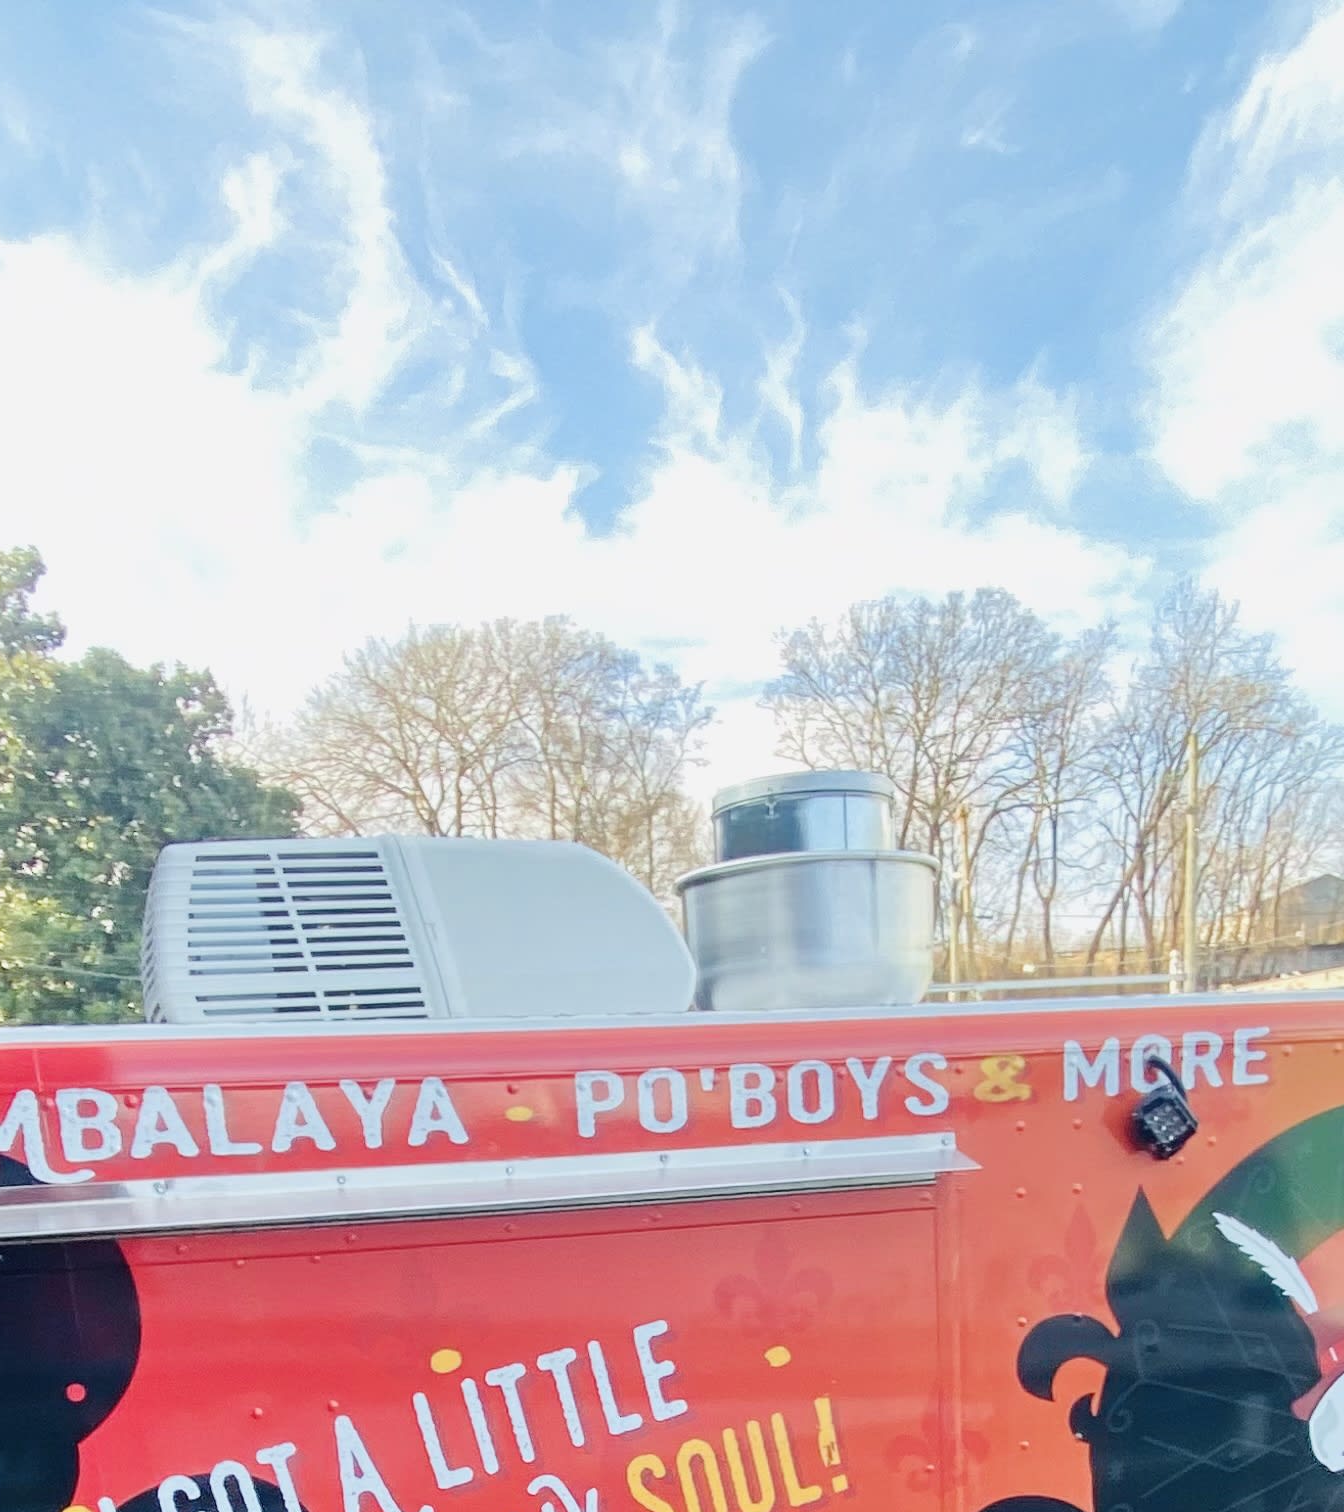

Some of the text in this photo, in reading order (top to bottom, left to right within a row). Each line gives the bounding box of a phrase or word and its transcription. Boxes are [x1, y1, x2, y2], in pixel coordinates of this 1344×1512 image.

[575, 1052, 953, 1138] PO'BOYS
[973, 1054, 1032, 1104] &
[1062, 1026, 1271, 1102] MORE
[411, 1319, 689, 1492] LITTLE
